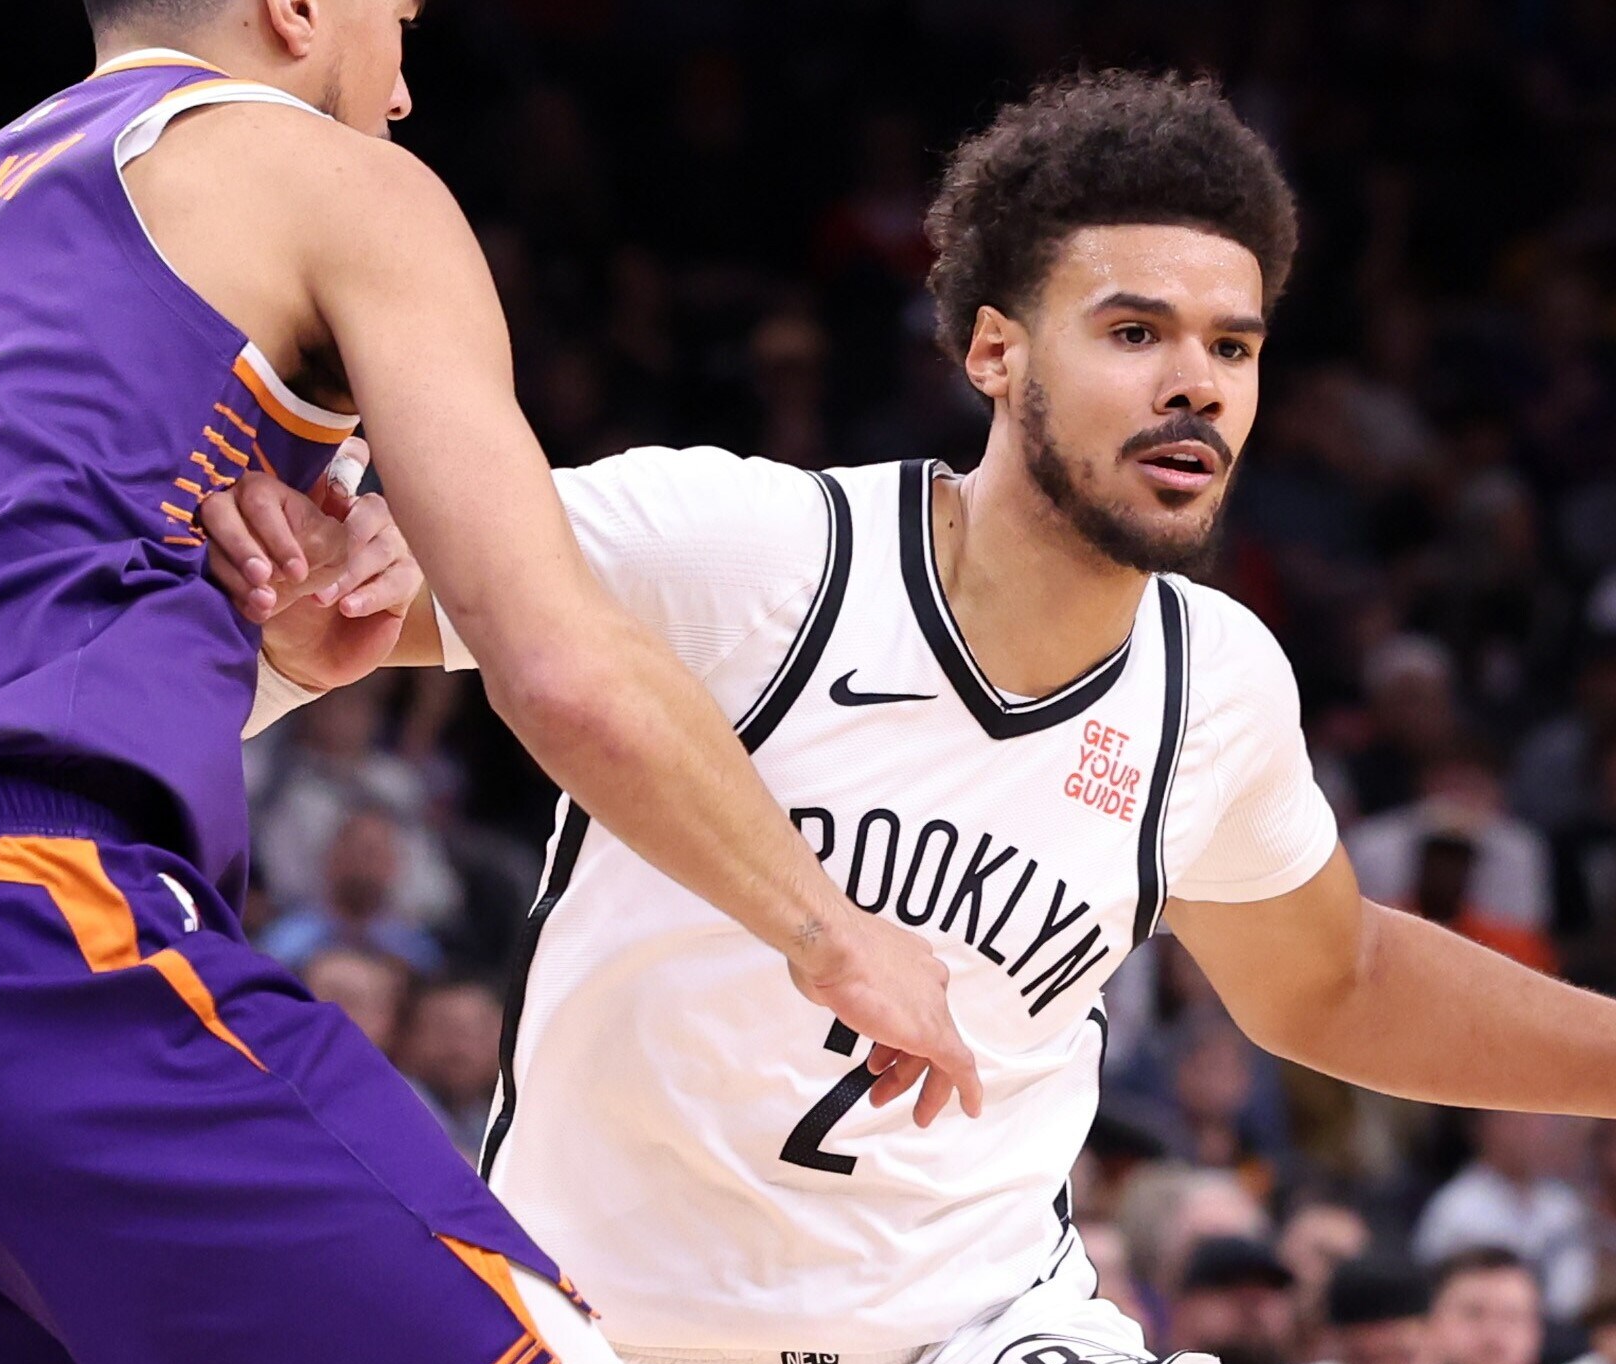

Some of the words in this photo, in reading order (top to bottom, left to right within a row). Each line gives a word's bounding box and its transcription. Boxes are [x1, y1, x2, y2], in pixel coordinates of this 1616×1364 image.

[1083, 719, 1130, 757] GET
[1078, 744, 1141, 795] YOUR
[1064, 772, 1137, 823] GUIDE
[789, 806, 1111, 1018] ROOKLYN
